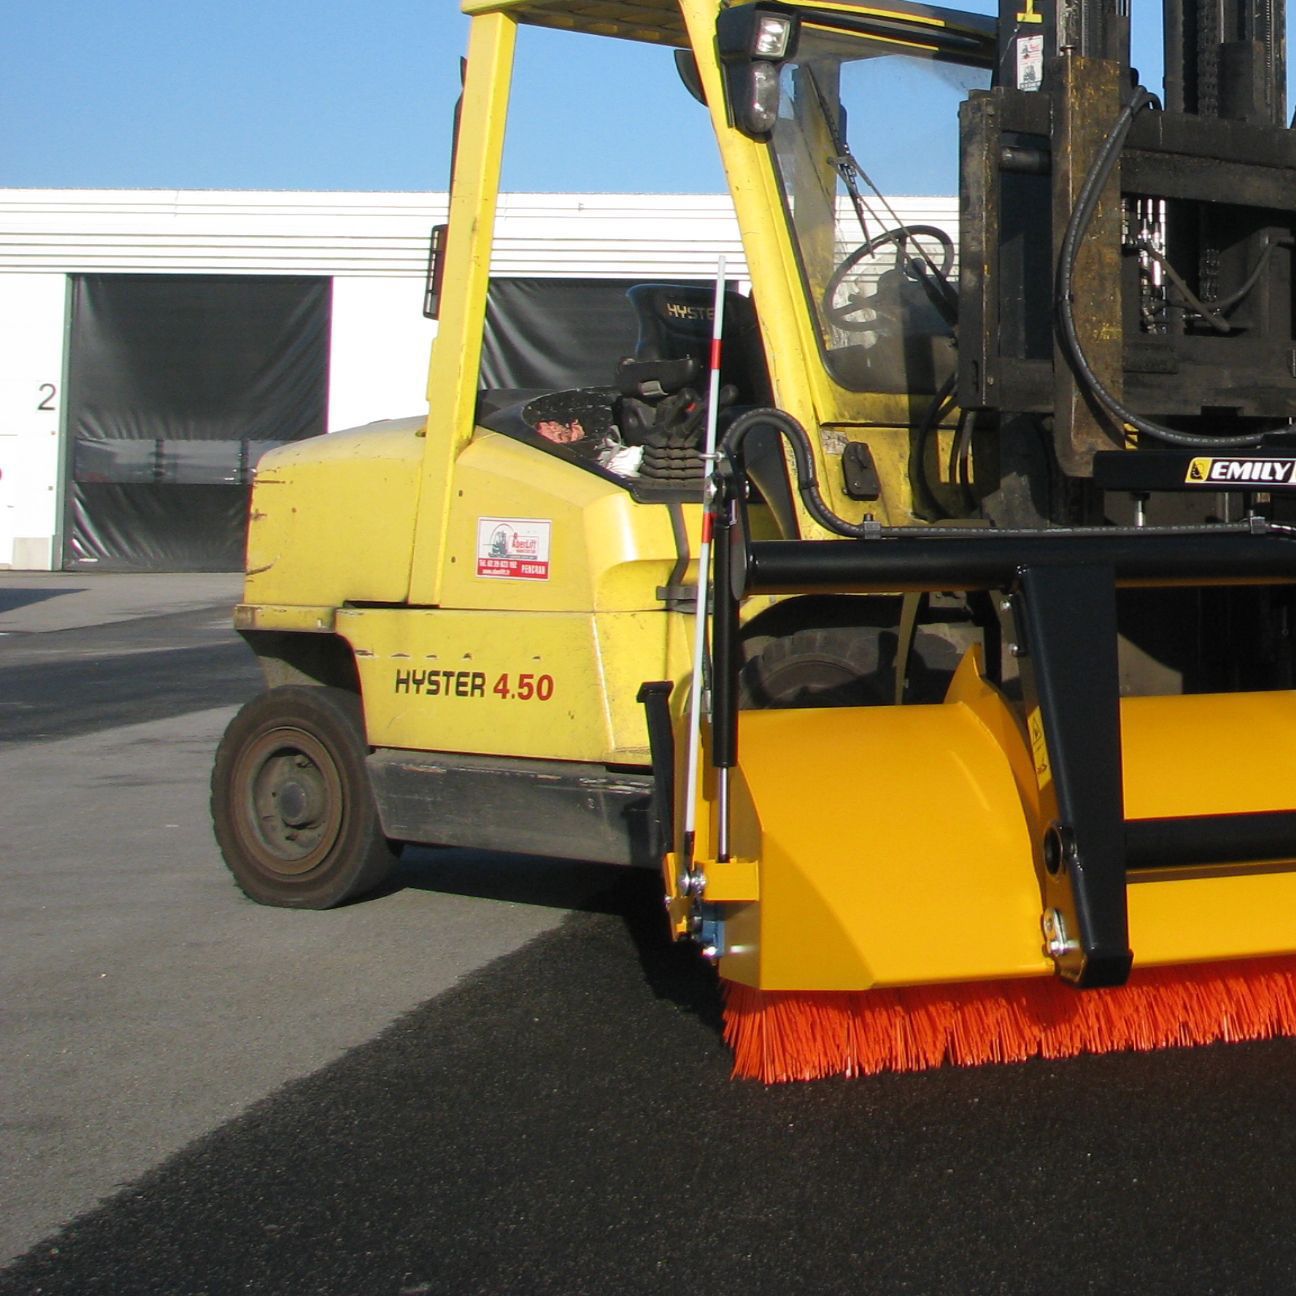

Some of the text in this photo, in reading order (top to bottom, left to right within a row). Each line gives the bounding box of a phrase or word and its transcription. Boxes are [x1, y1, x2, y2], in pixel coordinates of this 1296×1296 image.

[666, 303, 716, 320] HYSTE
[37, 383, 57, 411] 2
[1211, 461, 1291, 480] EMILY
[395, 669, 554, 701] HYSTER 4.50
